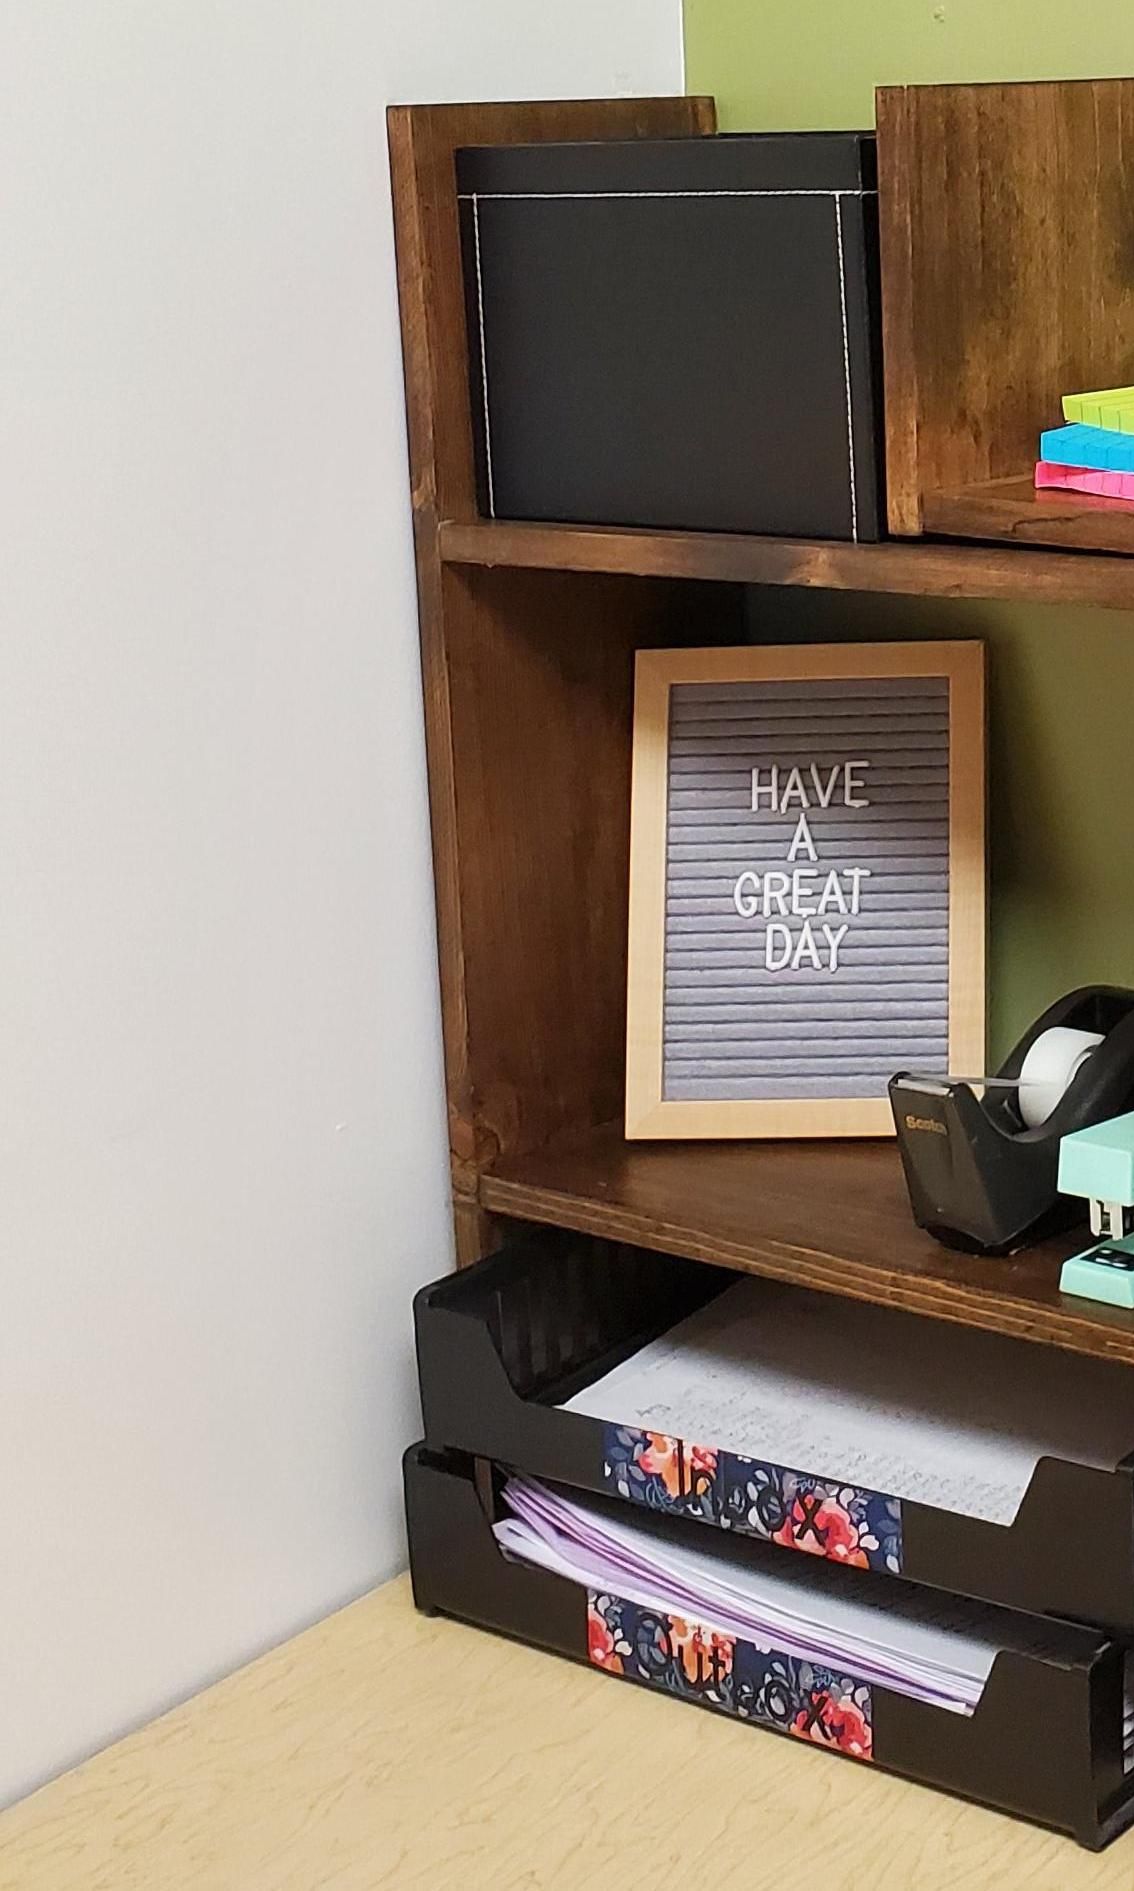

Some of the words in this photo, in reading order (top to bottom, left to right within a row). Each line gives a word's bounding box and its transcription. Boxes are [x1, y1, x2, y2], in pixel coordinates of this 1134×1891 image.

[752, 761, 870, 814] HAVE
[787, 812, 818, 861] A
[734, 867, 870, 918] GREAT
[766, 919, 848, 973] DAY
